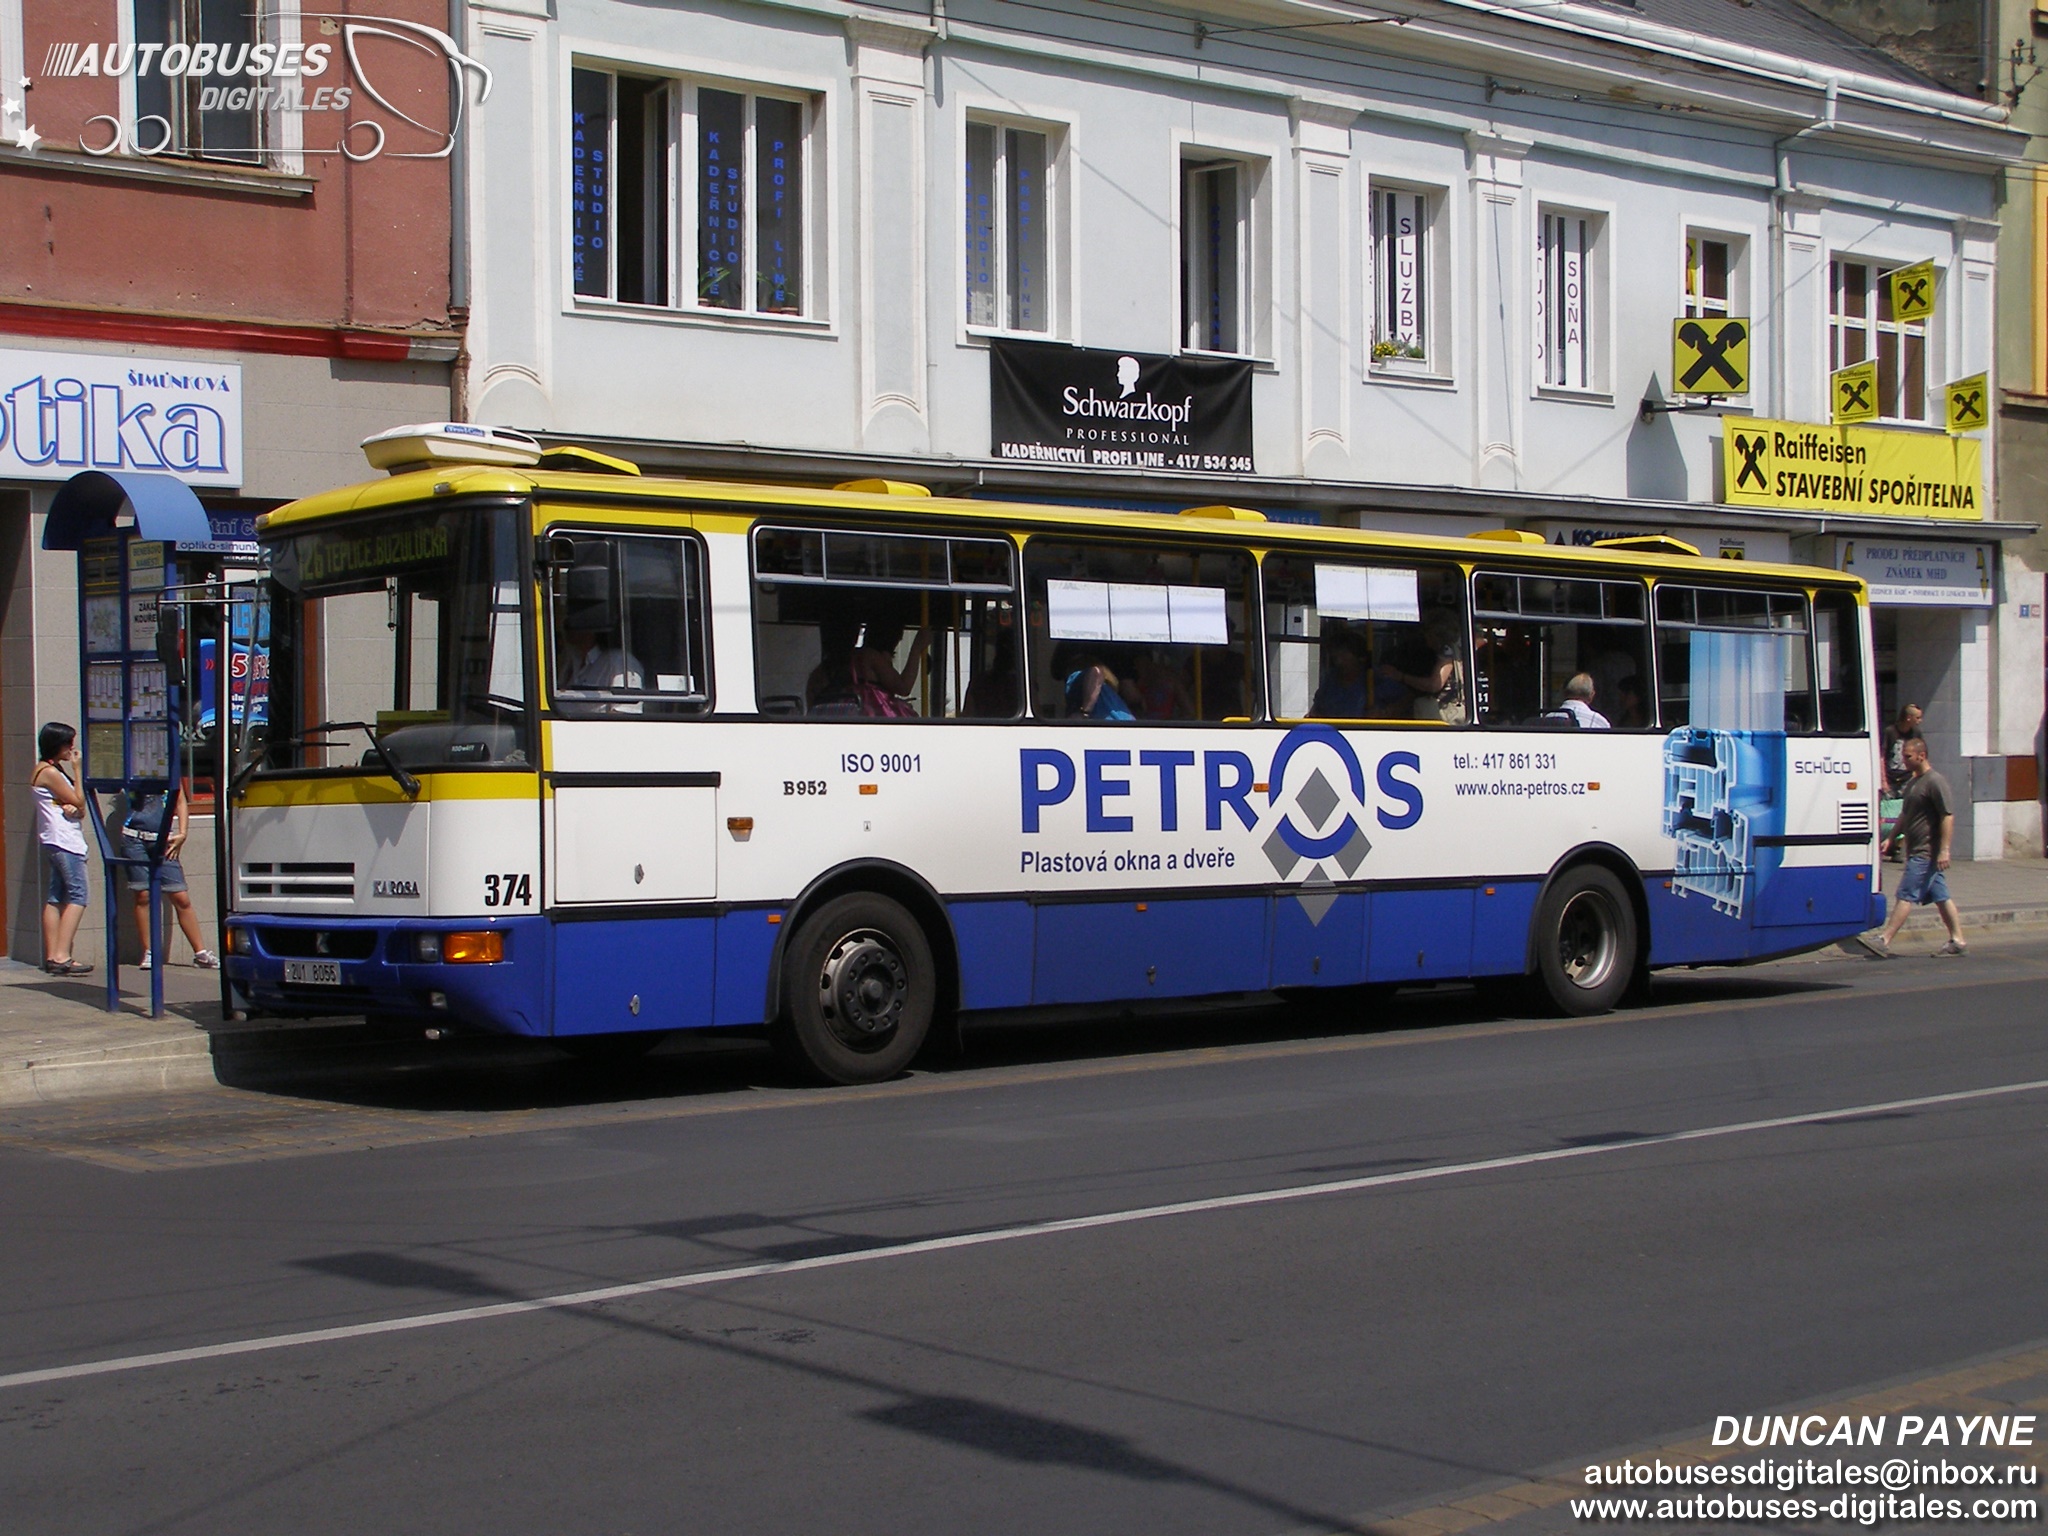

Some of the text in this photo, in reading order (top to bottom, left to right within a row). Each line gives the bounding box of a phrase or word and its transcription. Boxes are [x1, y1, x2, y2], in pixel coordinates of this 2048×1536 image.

[592, 150, 604, 249] STUDIO
[727, 168, 738, 264] STUDIO
[774, 141, 785, 301] PROFI LINE
[1021, 262, 1031, 319] LINE
[1567, 261, 1580, 344] SOŇA
[0, 375, 229, 473] tika
[1062, 386, 1192, 431] Schwarzkopf
[1066, 427, 1190, 445] PROFESSIONAL
[1774, 431, 1867, 466] Raiffeisen
[1001, 442, 1087, 464] KADEŘNICTVÍ
[1092, 450, 1132, 466] PROFI
[1136, 451, 1164, 467] LINE
[1176, 453, 1200, 469] 417
[1203, 455, 1227, 470] 534
[1230, 456, 1252, 471] 345
[1776, 470, 1975, 510] STAVEBNÍ SPOŘITELNA
[1866, 547, 1898, 560] PRODEJ
[1885, 565, 1947, 580] ZNÁMEK MHD
[840, 753, 922, 774] ISO 9001
[1453, 753, 1556, 769] tel.: 417 861 331
[783, 780, 827, 796] B952
[1020, 724, 1424, 859] PETROS
[1455, 780, 1585, 799] www.okna-petros.cz
[1020, 846, 1236, 874] Plastová okna a dveře
[373, 879, 420, 896] KAROSA
[484, 873, 532, 907] 374
